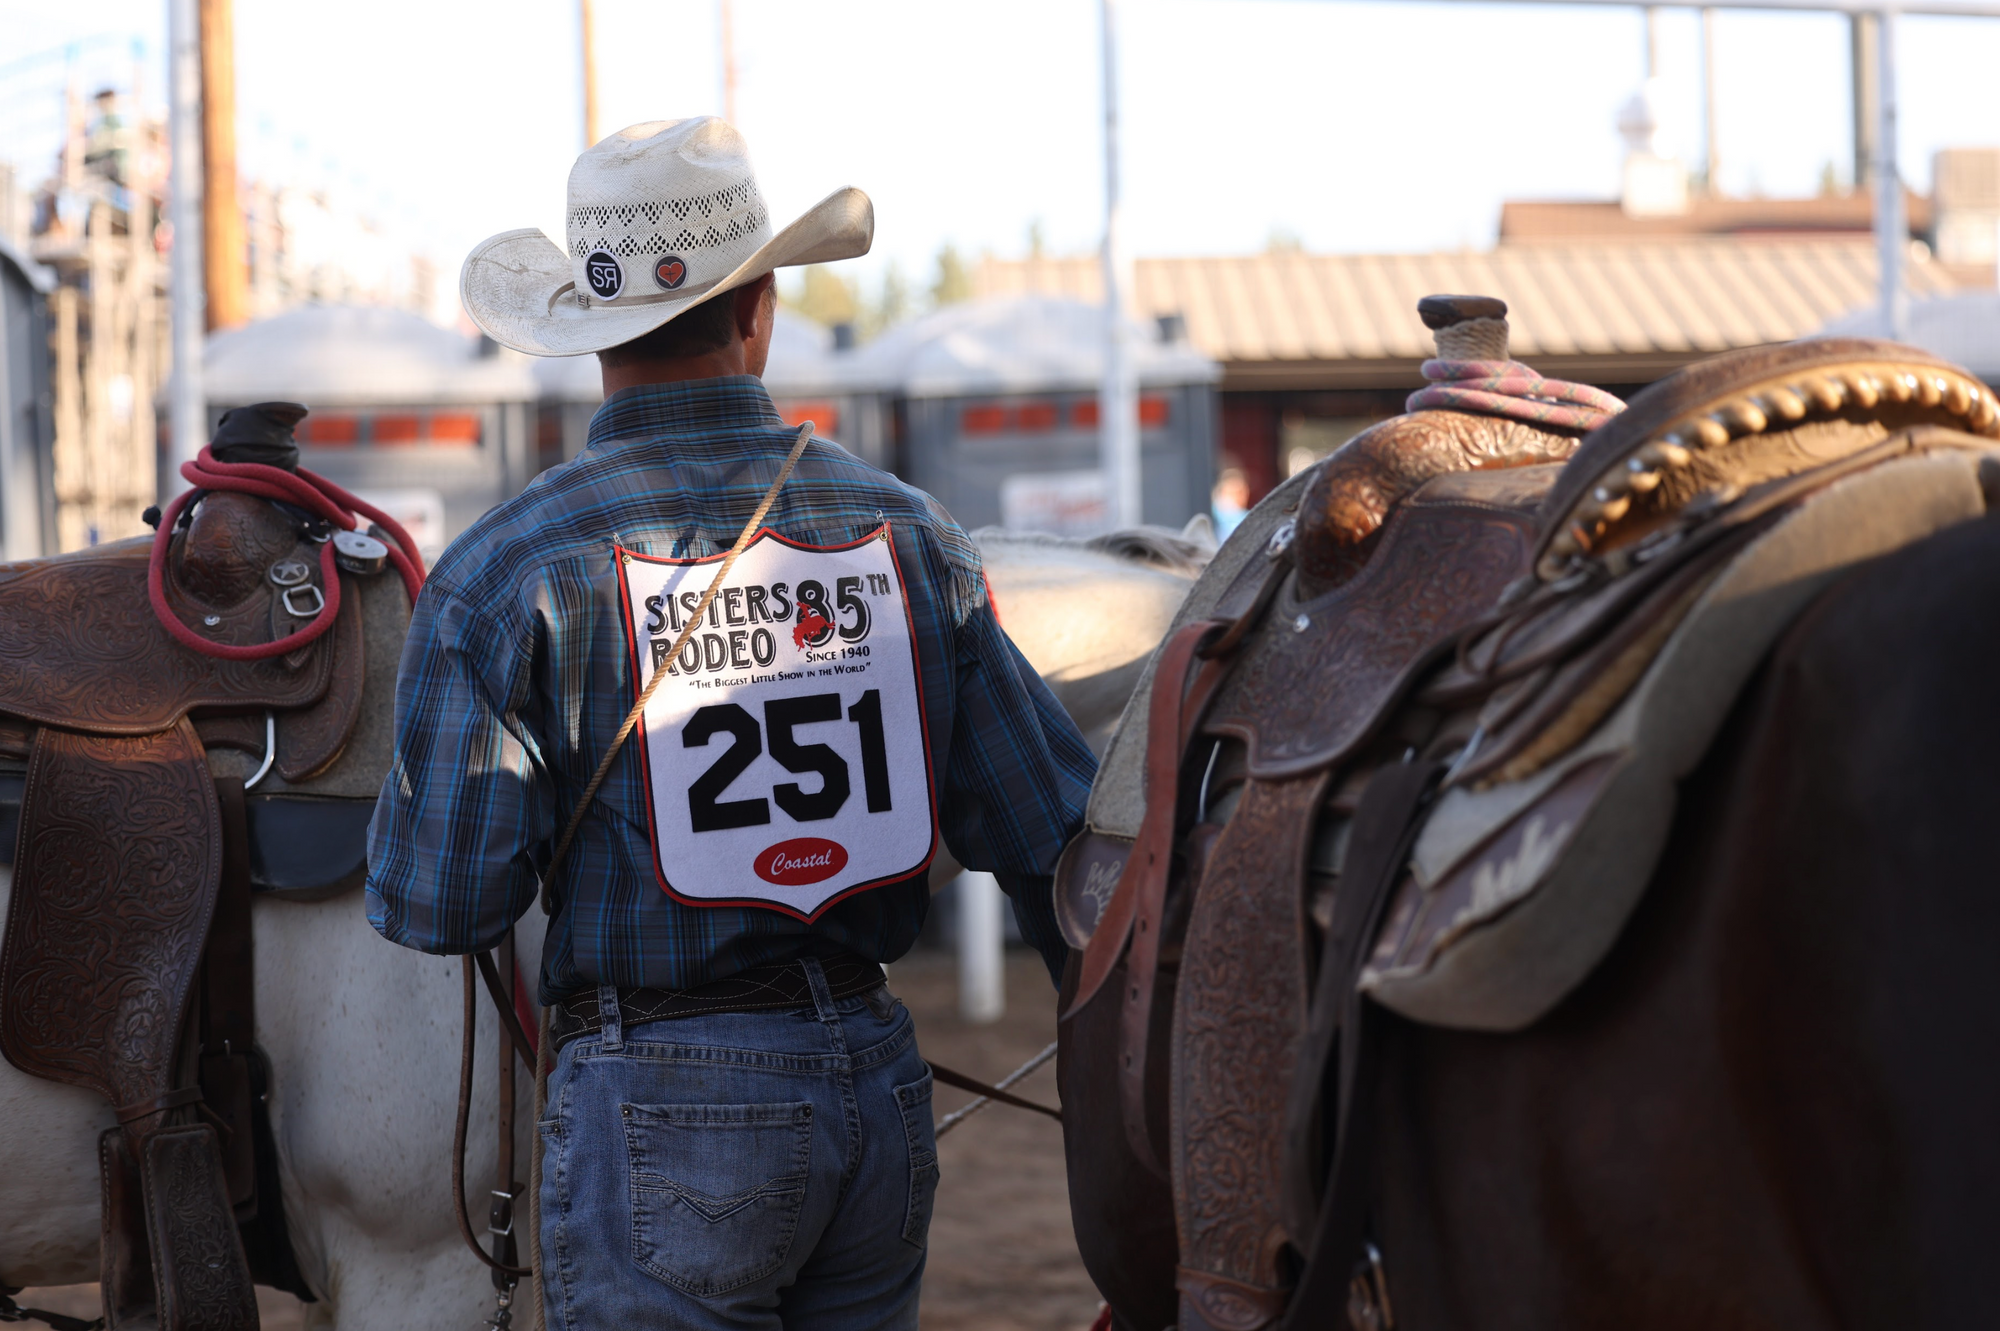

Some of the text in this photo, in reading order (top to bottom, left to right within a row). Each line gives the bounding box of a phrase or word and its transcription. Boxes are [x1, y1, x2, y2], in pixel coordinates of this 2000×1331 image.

[645, 582, 794, 635] SISTERS
[649, 627, 777, 677] RODEO
[806, 645, 871, 663] SINCE 1940
[715, 677, 748, 688] BIGGEST
[751, 674, 776, 684] LITTLE
[778, 671, 804, 681] SHOW
[682, 689, 893, 833] 251
[770, 849, 832, 876] Coastal
